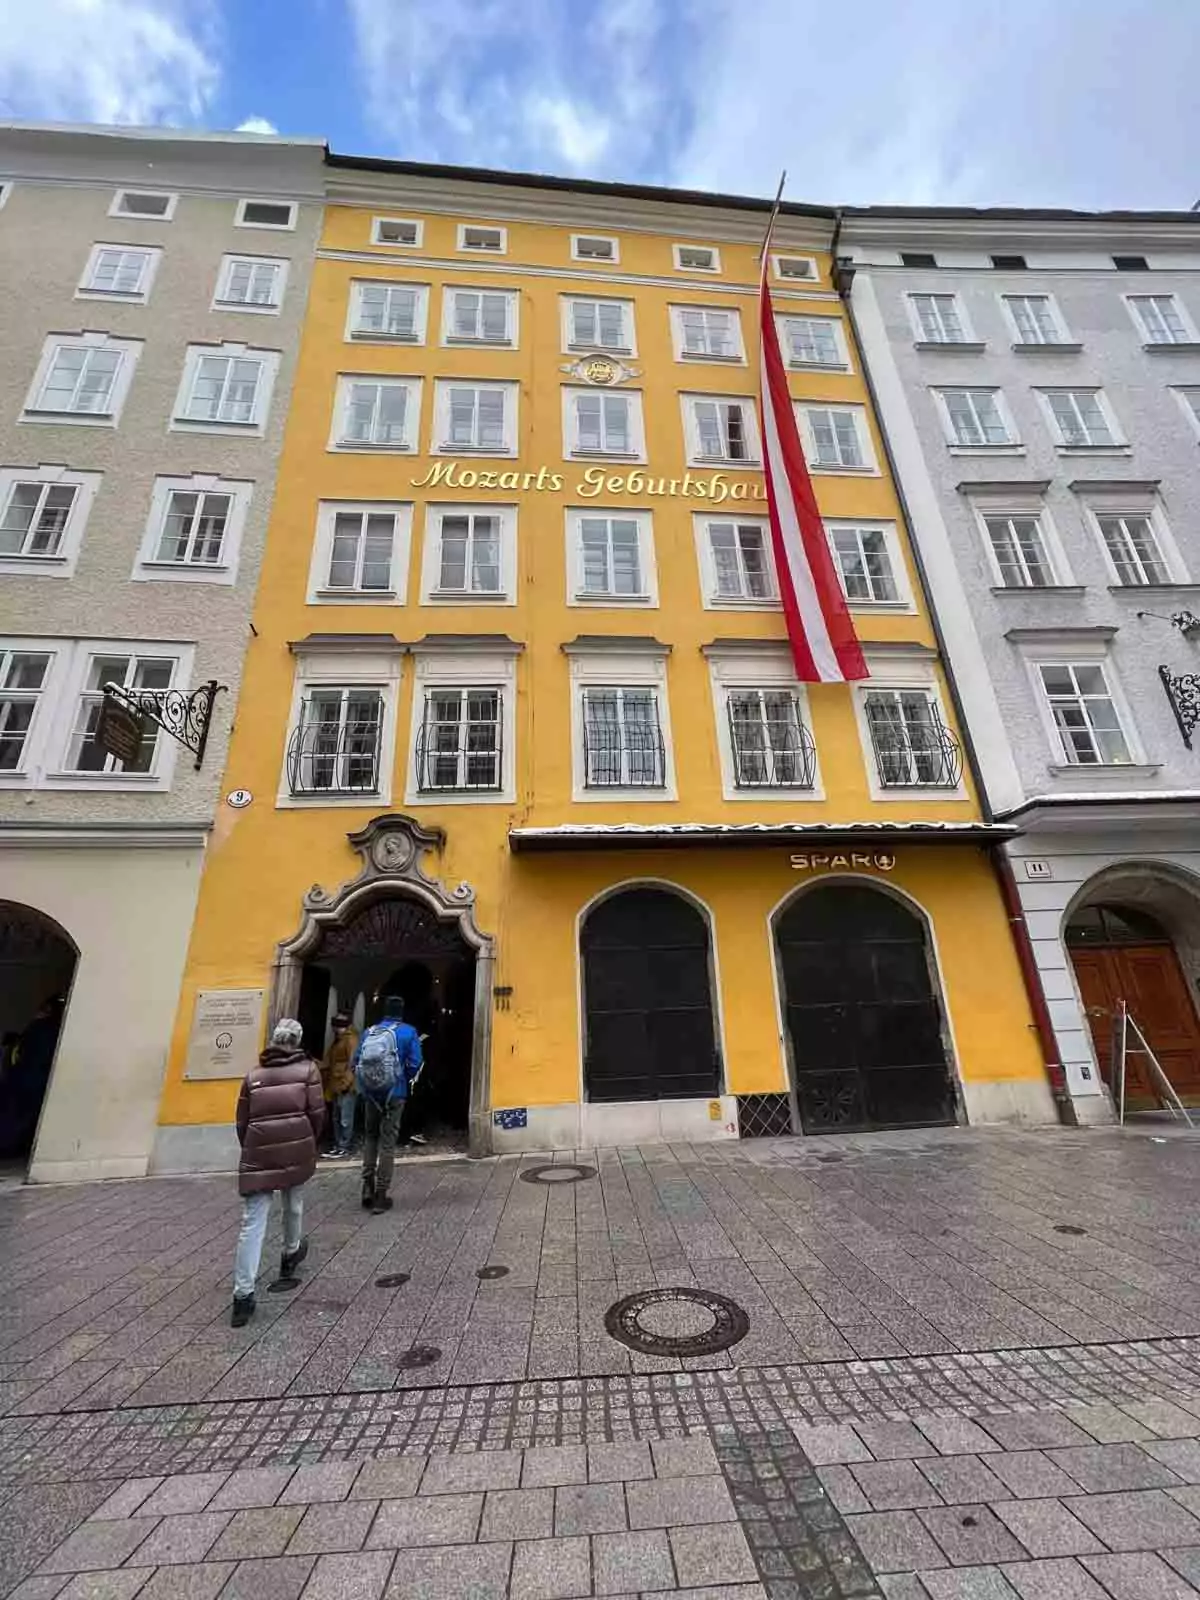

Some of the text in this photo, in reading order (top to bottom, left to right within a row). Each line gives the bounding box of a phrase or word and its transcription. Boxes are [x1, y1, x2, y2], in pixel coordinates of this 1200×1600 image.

[410, 461, 768, 504] Mozarts Geburtshau
[236, 791, 243, 801] 9
[790, 853, 871, 869] SPAR
[1032, 863, 1043, 872] 11
